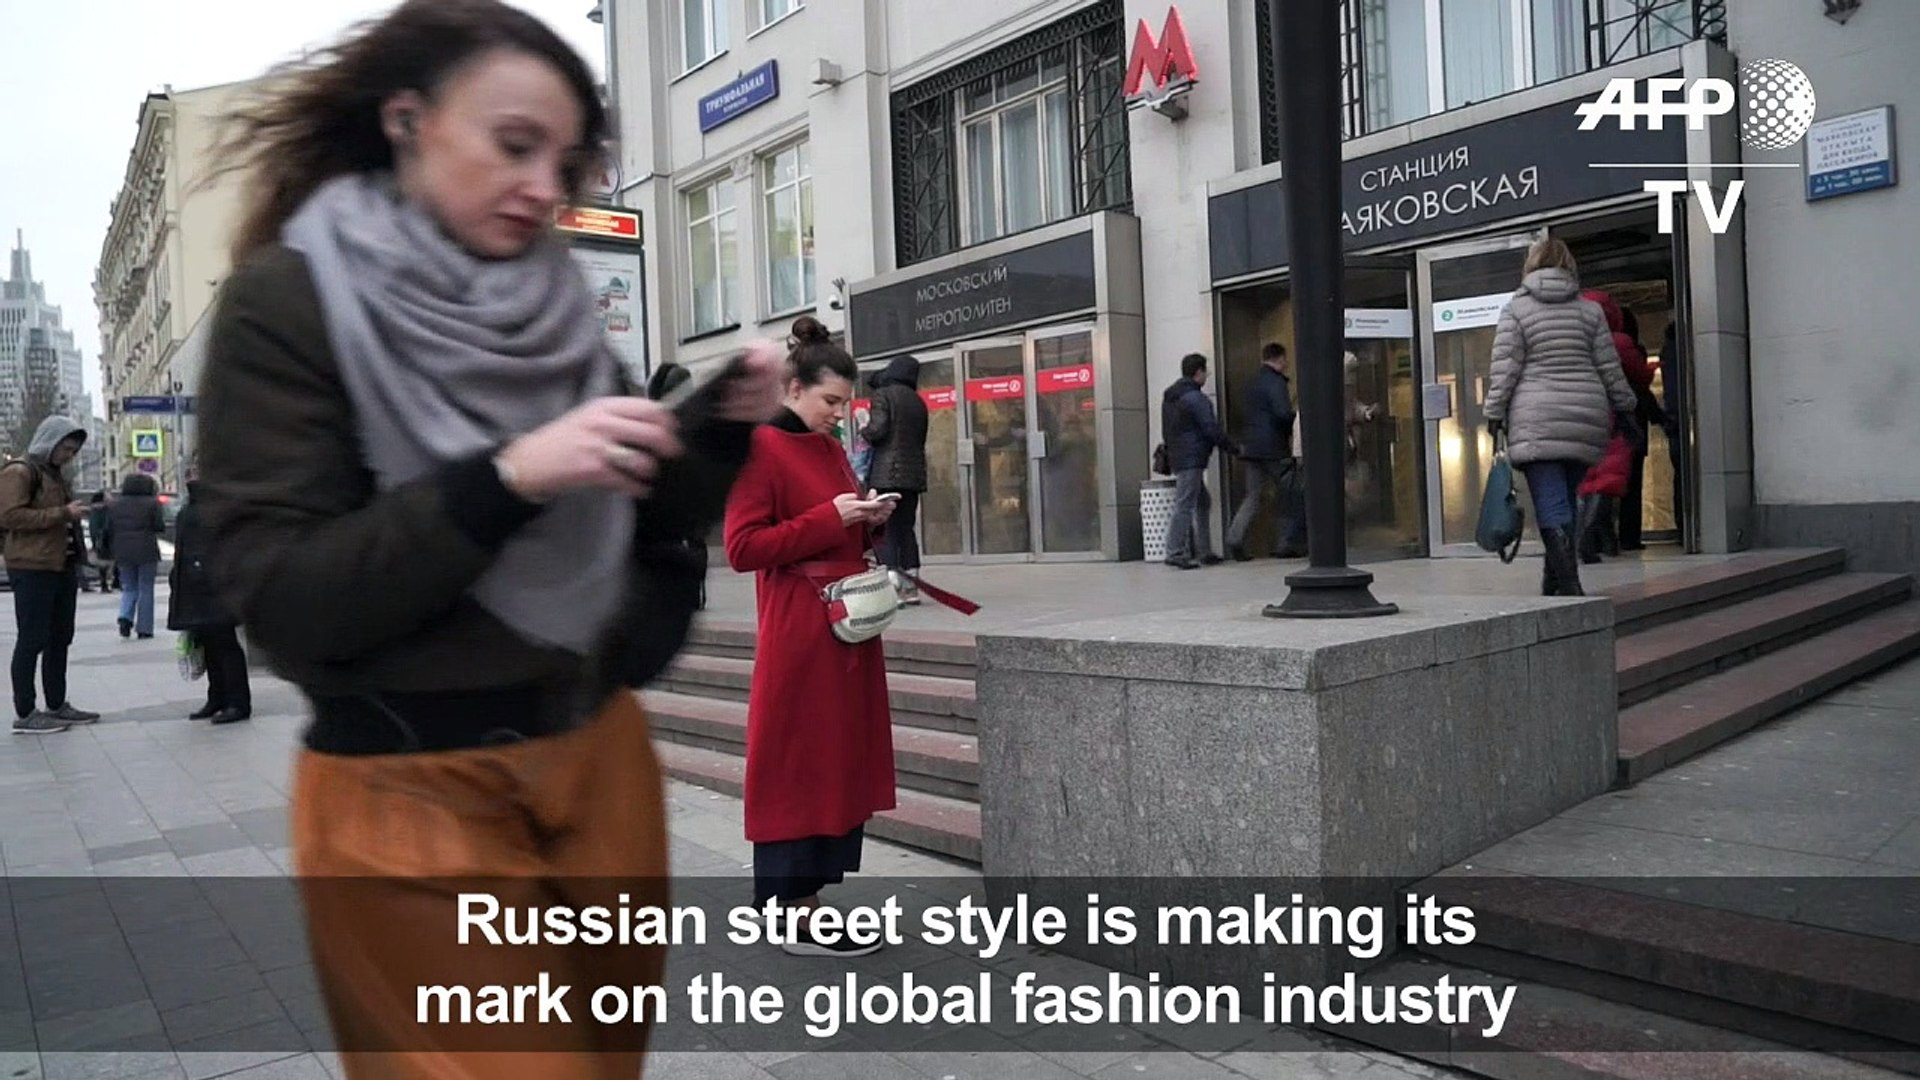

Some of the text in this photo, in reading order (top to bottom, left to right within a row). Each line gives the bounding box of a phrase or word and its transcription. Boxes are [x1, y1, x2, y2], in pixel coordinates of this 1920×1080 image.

[1360, 145, 1470, 192] СТАНЦИЯ
[1341, 165, 1539, 236] АЯКОВСКАЯ
[915, 261, 1008, 304] МОСКОВСКИЙ
[914, 296, 1012, 333] МЕТРОПОЛИТЕН
